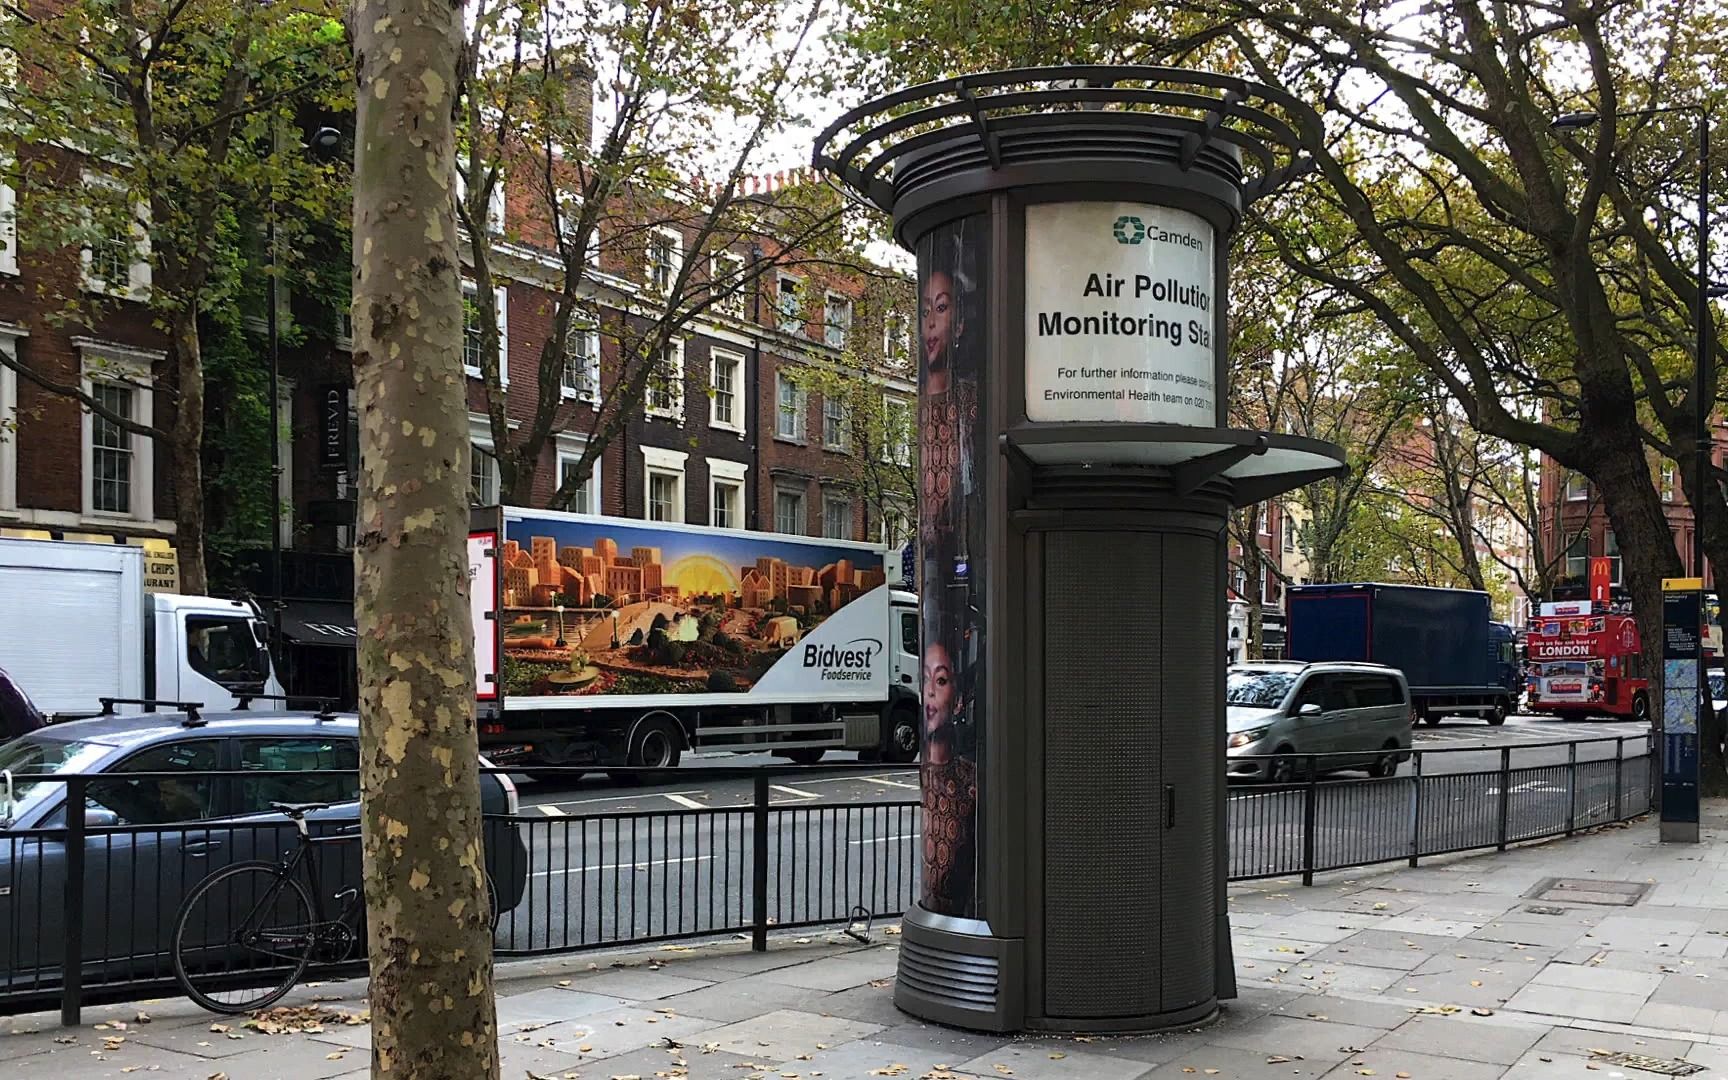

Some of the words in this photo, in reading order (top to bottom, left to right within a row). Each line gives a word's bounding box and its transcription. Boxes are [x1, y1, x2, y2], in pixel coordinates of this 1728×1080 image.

[1147, 226, 1203, 251] Camden
[1083, 273, 1125, 297] Air
[1038, 311, 1182, 347] Monitoring
[1188, 320, 1212, 349] Sta
[1058, 367, 1078, 379] For
[1081, 367, 1117, 379] further
[1120, 367, 1174, 382] information
[1175, 373, 1198, 386] please
[1044, 389, 1126, 401] Environmental
[1128, 389, 1161, 402] Health
[1163, 393, 1183, 404] team
[1184, 396, 1194, 406] on
[151, 562, 175, 575] CHIPS
[803, 644, 872, 668] Bidvest
[1539, 645, 1589, 656] LONDON
[821, 669, 872, 681] Foodservice
